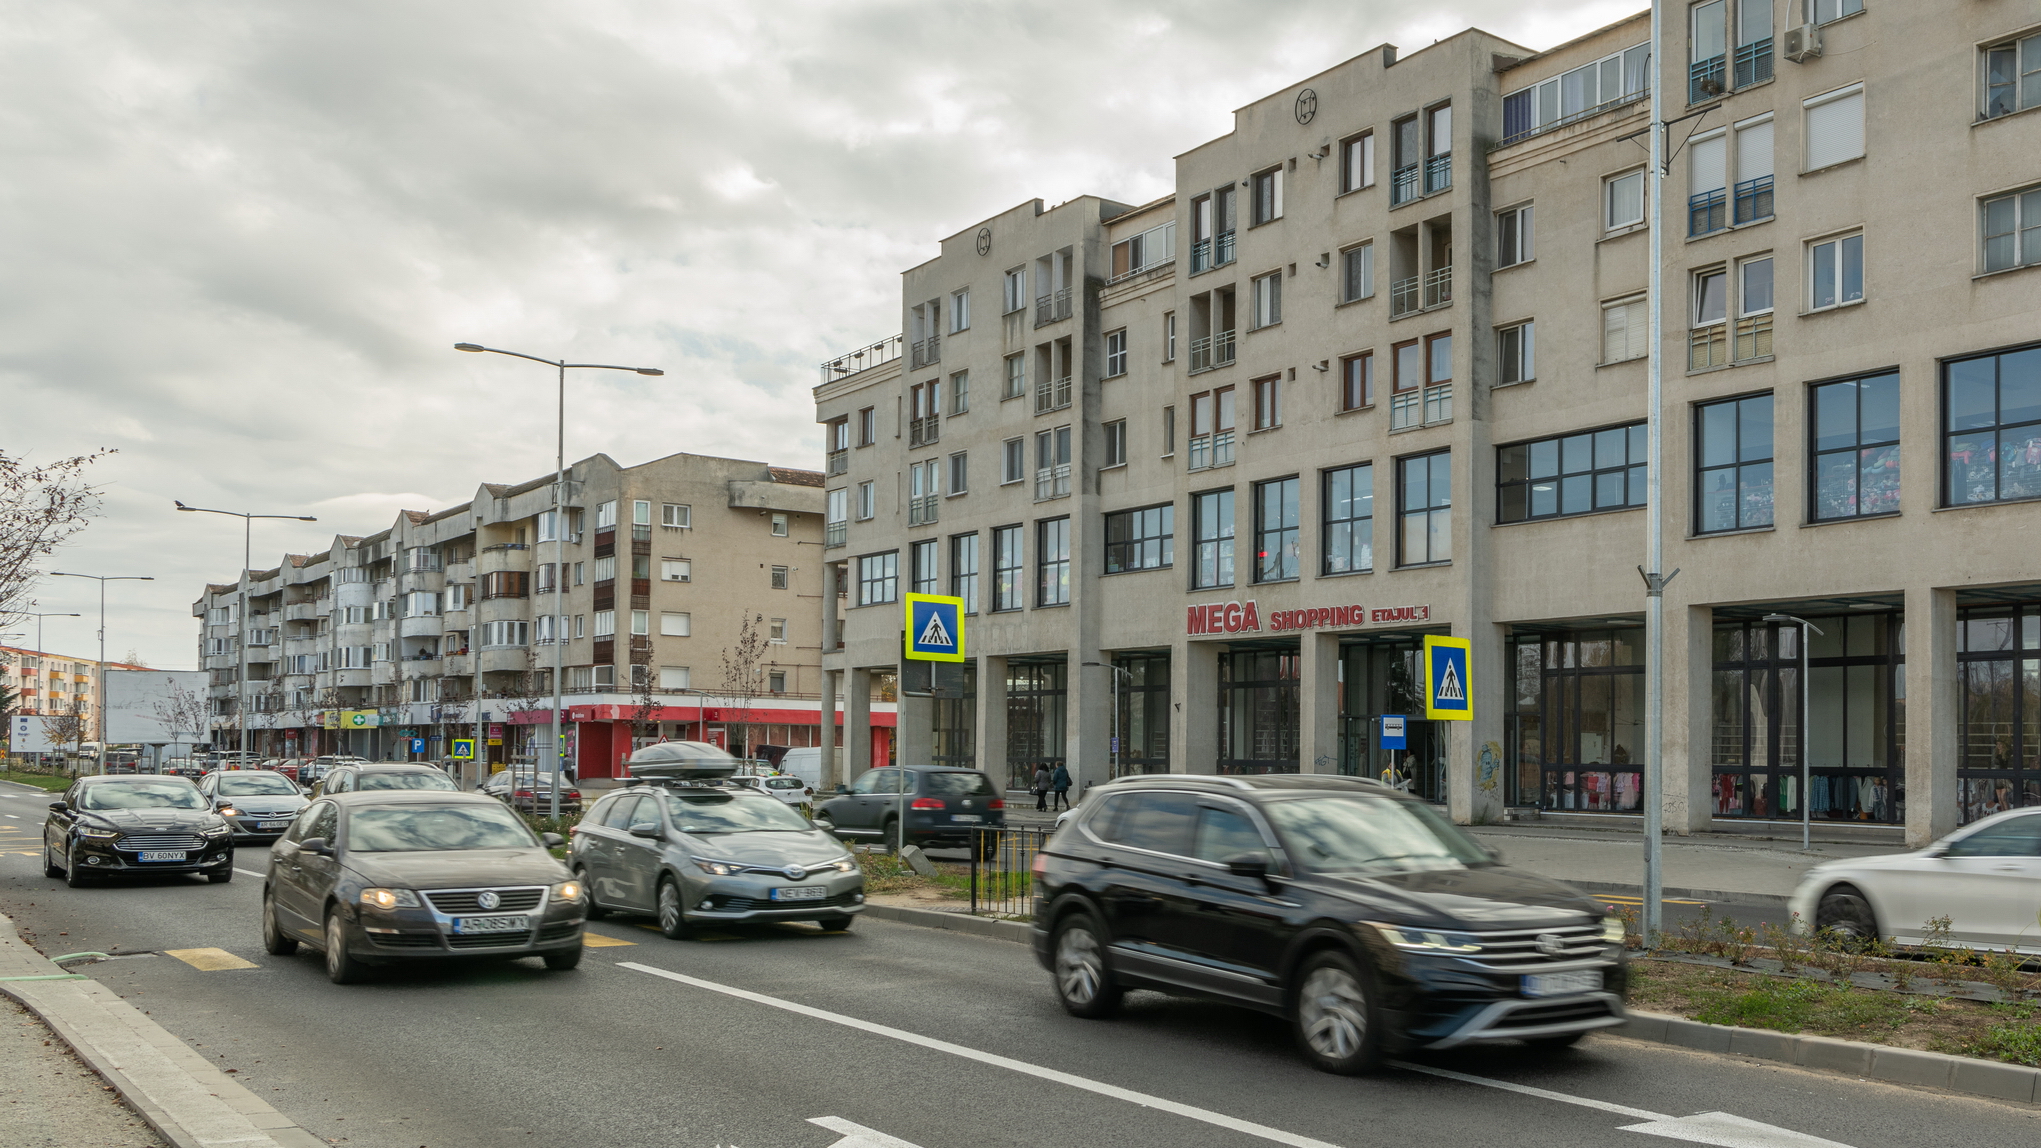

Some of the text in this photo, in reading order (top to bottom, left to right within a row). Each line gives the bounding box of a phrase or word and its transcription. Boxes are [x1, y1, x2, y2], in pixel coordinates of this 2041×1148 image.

[1187, 600, 1430, 636] MEGA SHOPPING ETAJUL 1
[414, 740, 422, 751] P
